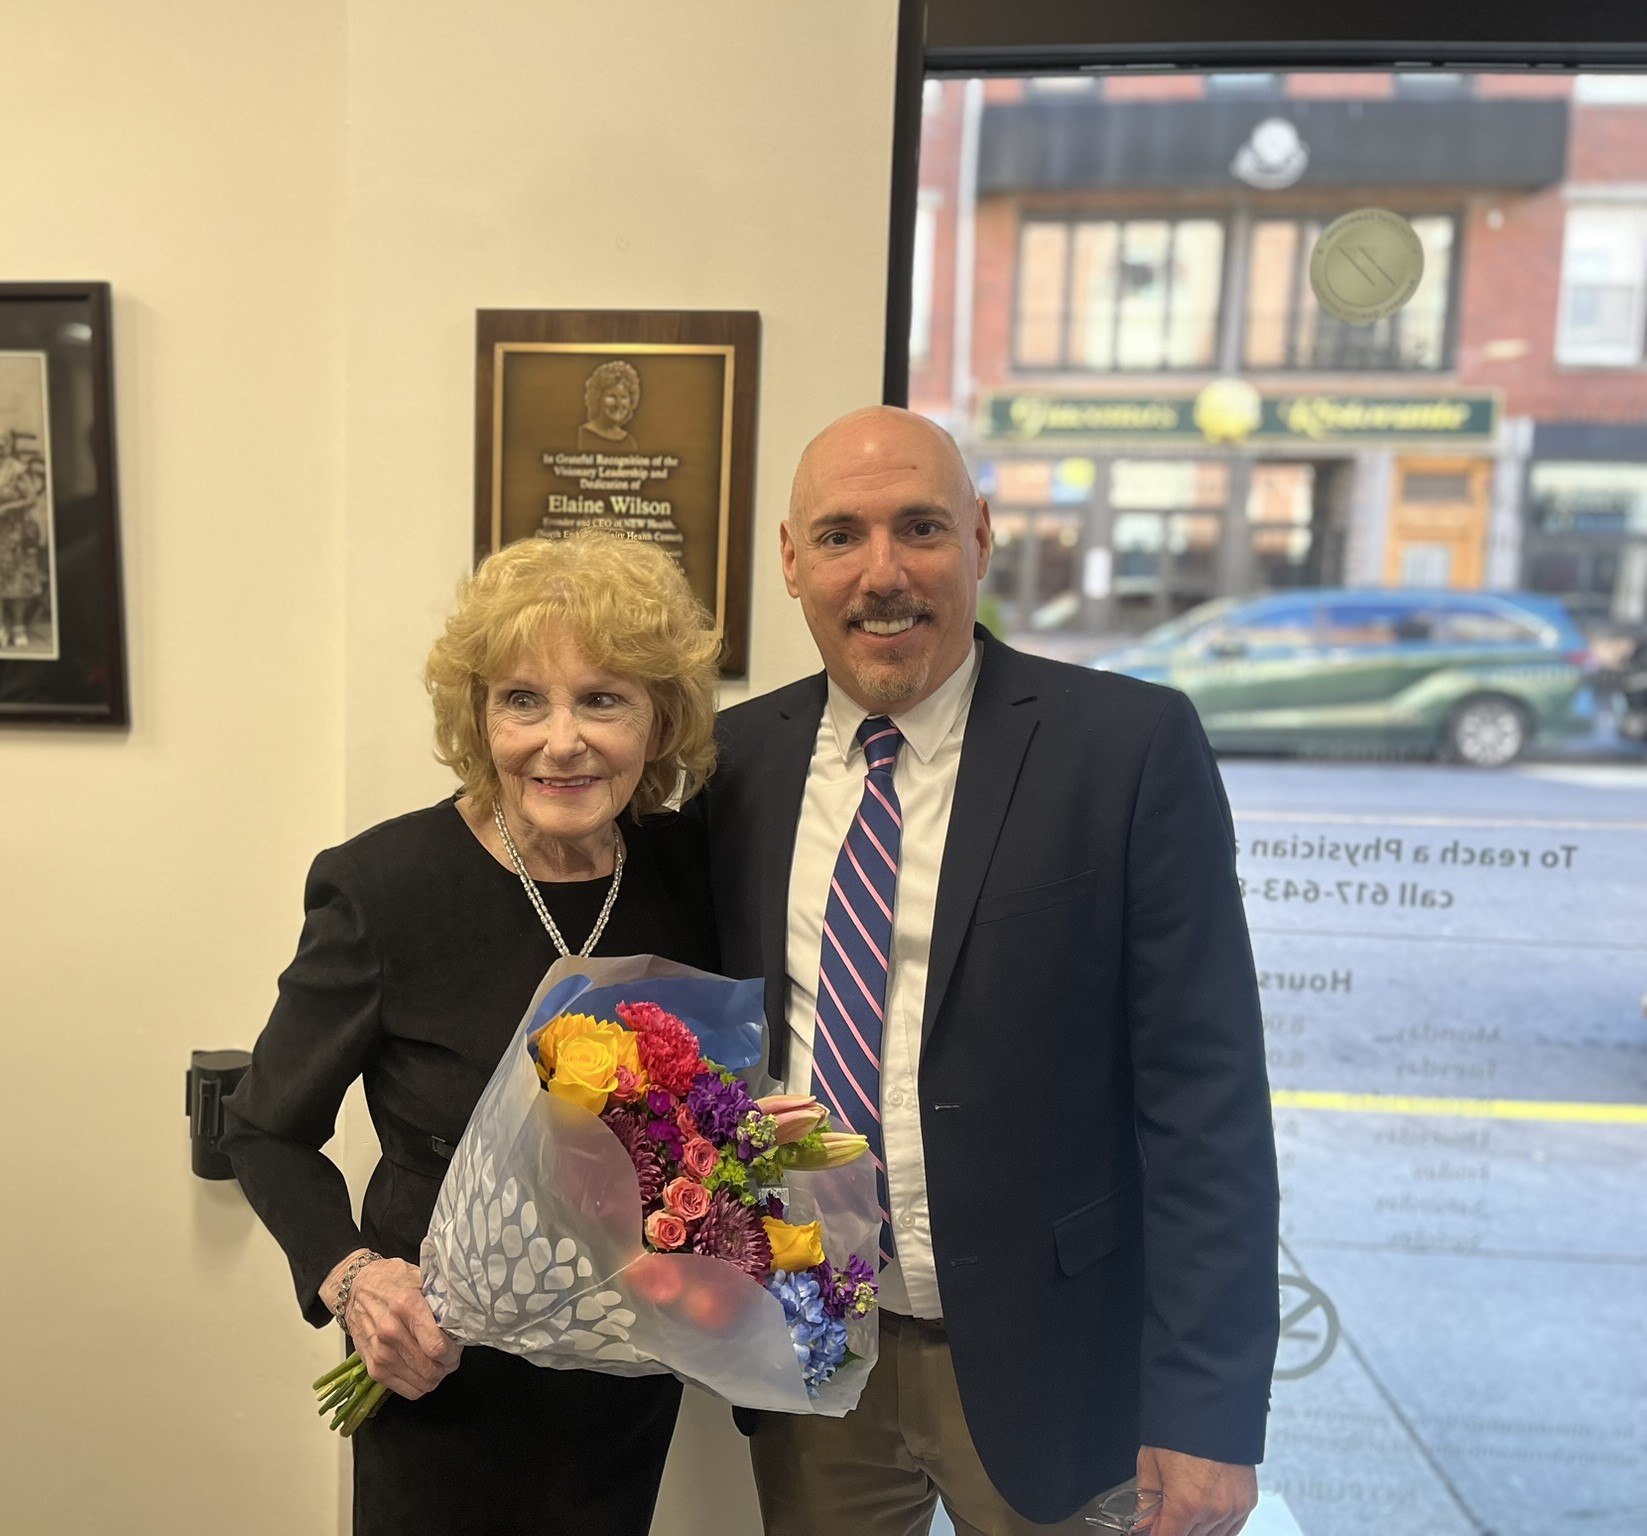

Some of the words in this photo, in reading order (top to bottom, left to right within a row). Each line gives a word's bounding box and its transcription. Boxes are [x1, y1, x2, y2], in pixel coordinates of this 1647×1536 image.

[543, 454, 553, 464] In
[556, 454, 594, 464] Grateful
[596, 454, 650, 468] Recognition
[651, 455, 662, 465] of
[663, 456, 679, 466] the
[554, 466, 596, 479] Visionary
[599, 467, 648, 480] Leadership
[650, 468, 668, 478] and
[580, 479, 628, 489] Dedication
[630, 479, 641, 489] of
[548, 495, 604, 512] Elaine
[610, 495, 671, 515] Wilson
[592, 518, 612, 527] CEO
